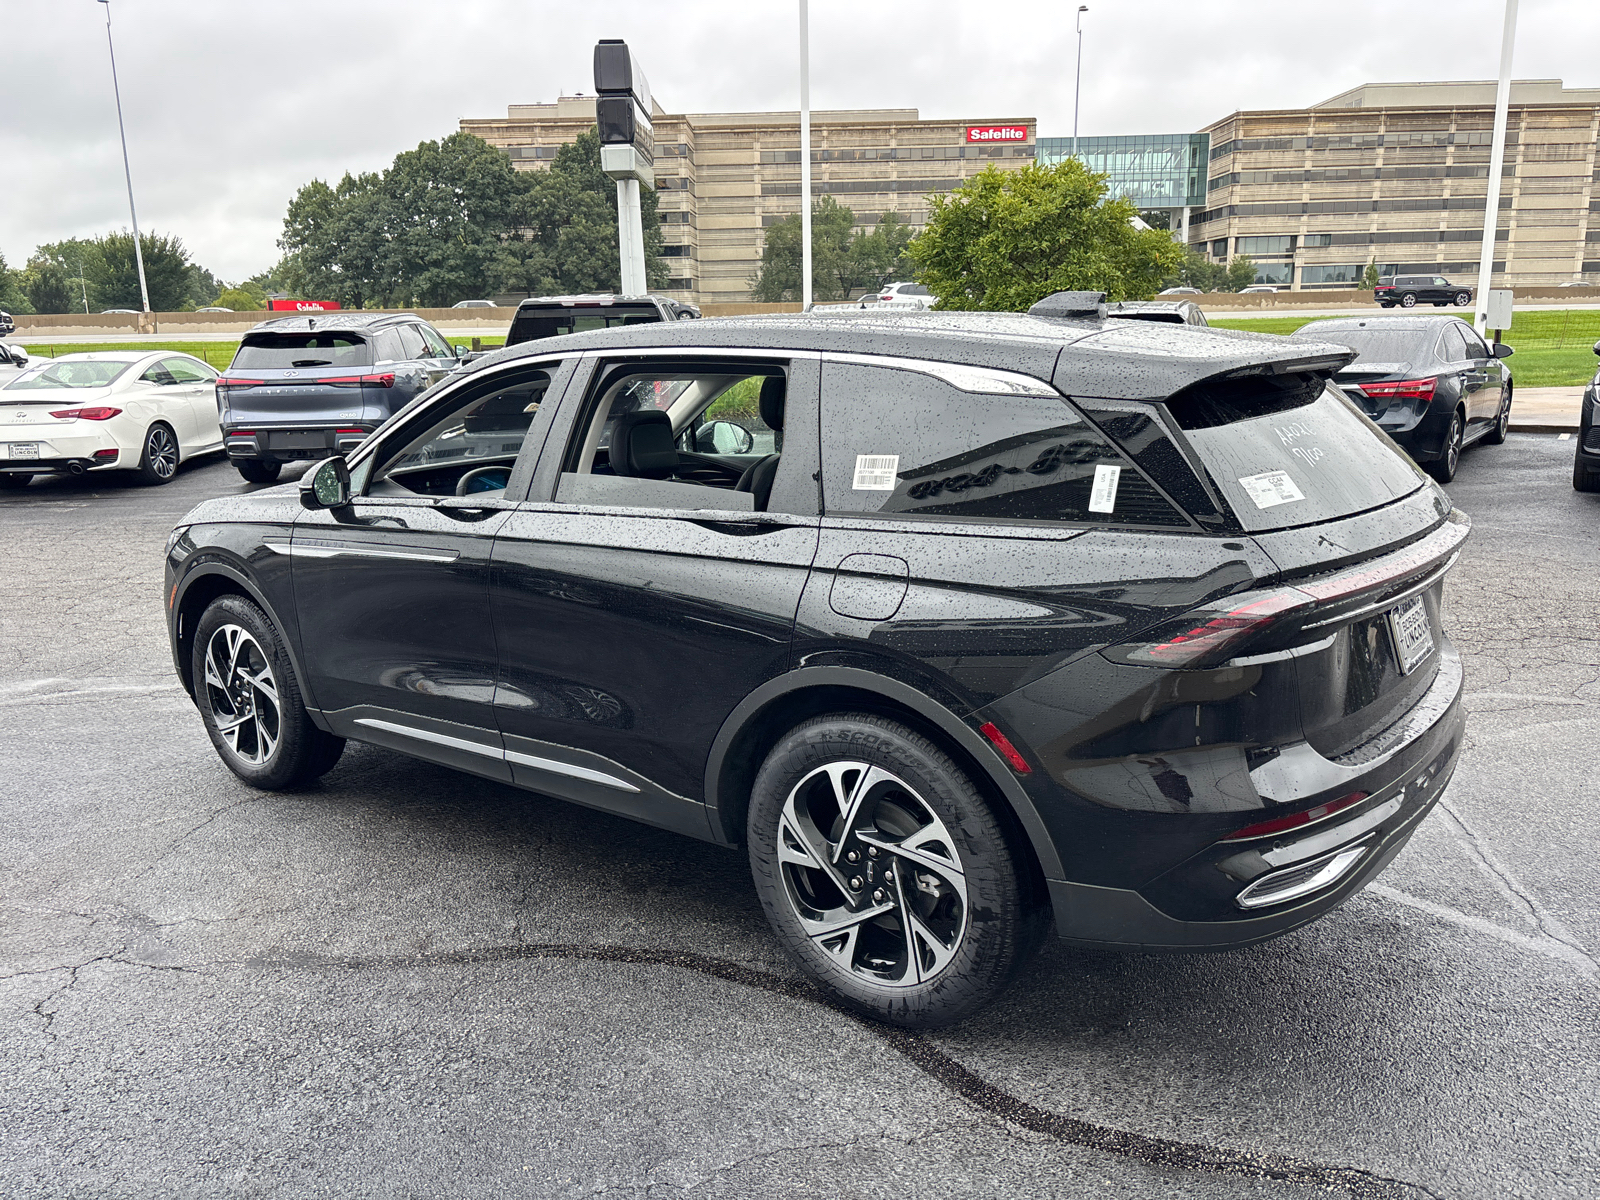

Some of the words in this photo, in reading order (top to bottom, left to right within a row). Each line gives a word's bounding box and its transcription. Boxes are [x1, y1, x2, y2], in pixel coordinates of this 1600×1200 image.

[970, 128, 1024, 140] Safelite
[296, 302, 325, 312] Safelite
[1403, 620, 1429, 649] LINCOLN
[837, 729, 941, 787] SCORPION
